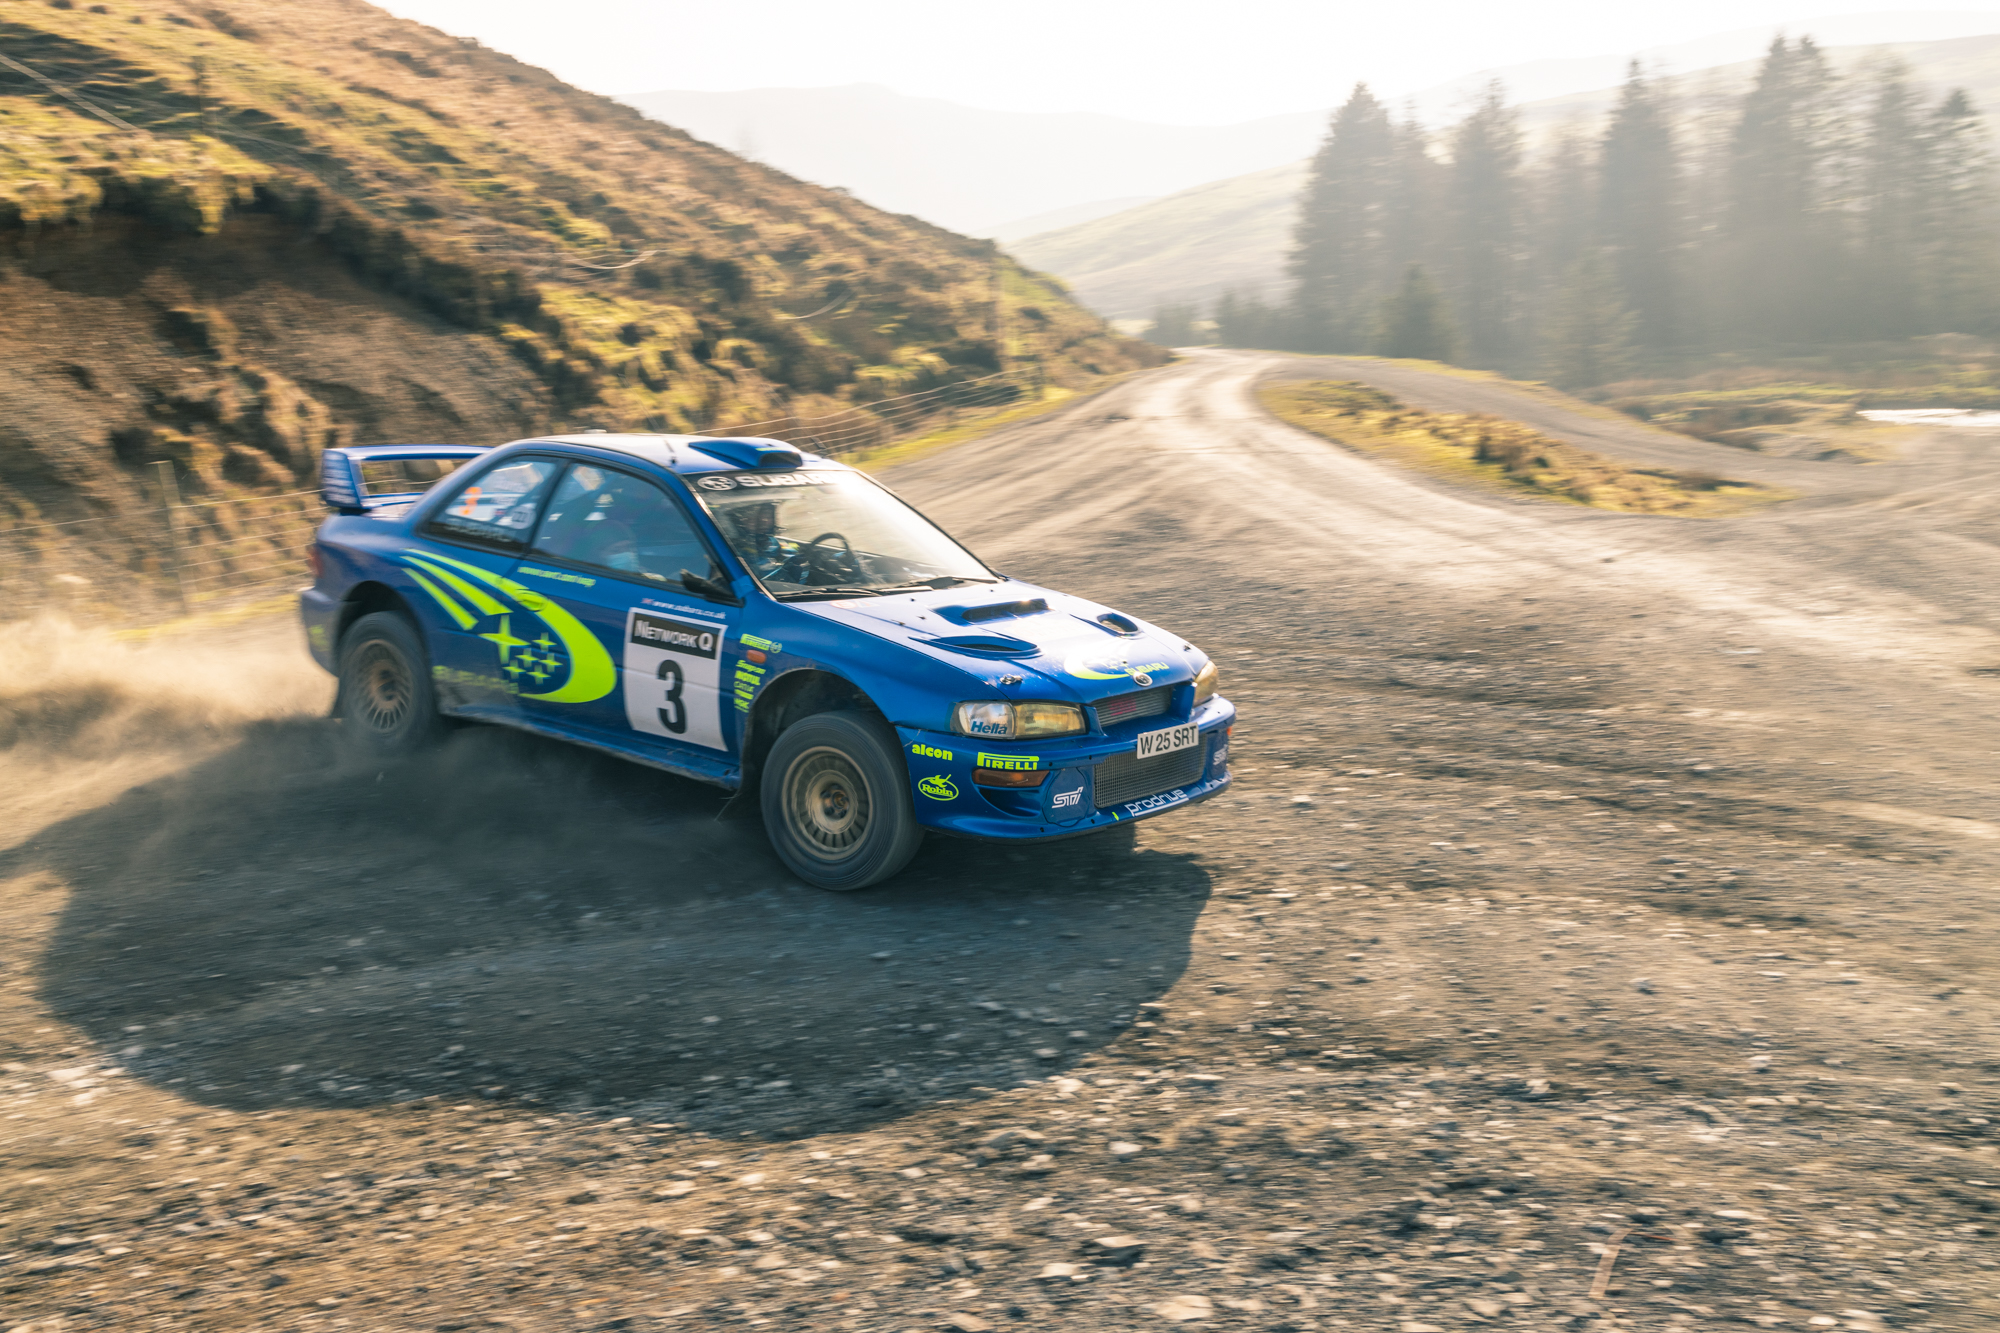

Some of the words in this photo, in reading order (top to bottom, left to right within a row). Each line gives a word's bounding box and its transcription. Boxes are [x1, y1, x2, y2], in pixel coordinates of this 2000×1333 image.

[734, 473, 836, 487] SUBAR
[698, 633, 713, 651] Q
[657, 659, 687, 734] 3
[970, 721, 1007, 735] Hella
[1140, 735, 1154, 755] W
[1155, 731, 1171, 751] 25
[1173, 725, 1197, 748] SRT
[912, 744, 953, 761] alcon
[977, 752, 1039, 770] PIRELLI
[922, 783, 954, 797] Robin
[1124, 789, 1188, 817] prodrive
